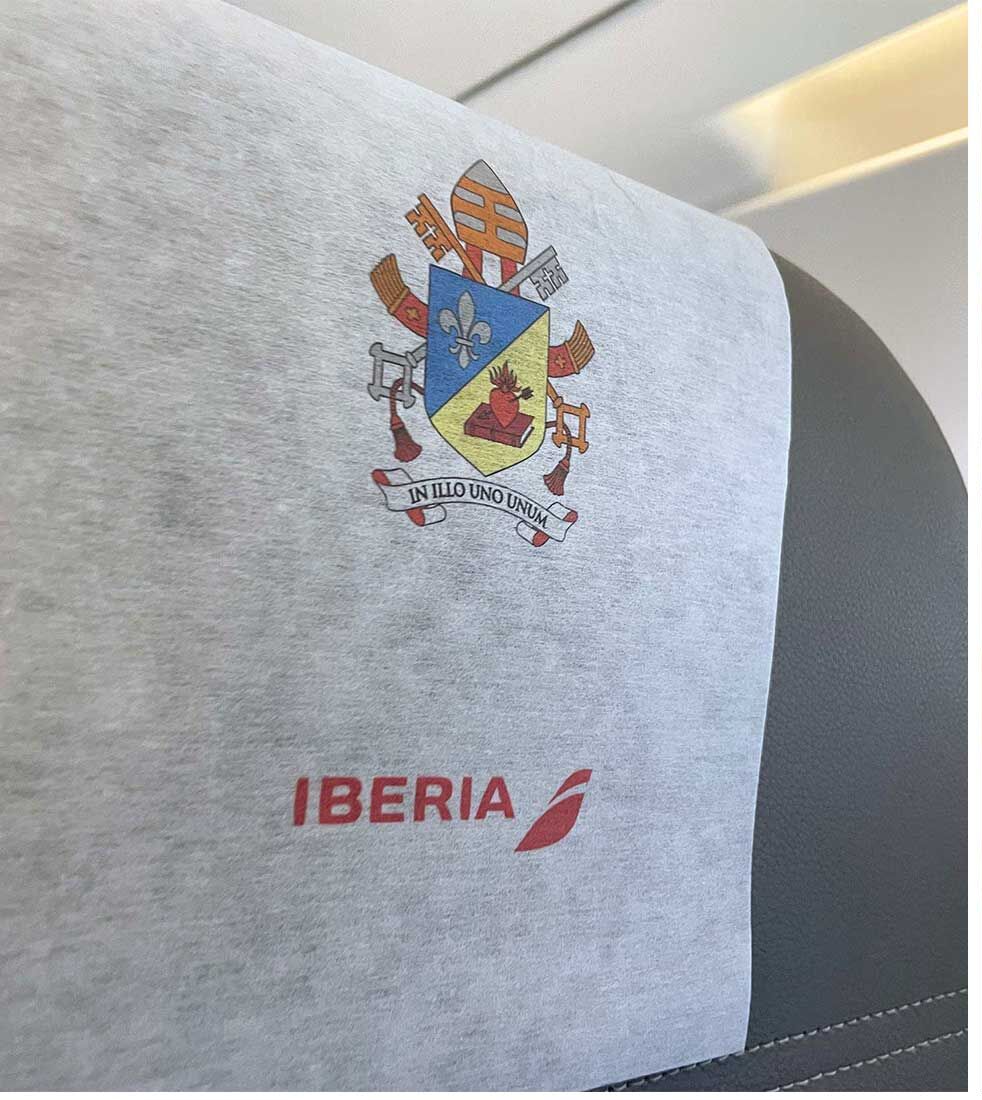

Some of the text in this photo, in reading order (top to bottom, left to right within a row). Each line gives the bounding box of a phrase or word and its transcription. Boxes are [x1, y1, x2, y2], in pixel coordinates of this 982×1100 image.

[408, 482, 549, 529] IN ILLO UNO UNUM
[293, 775, 515, 826] IBERIA
